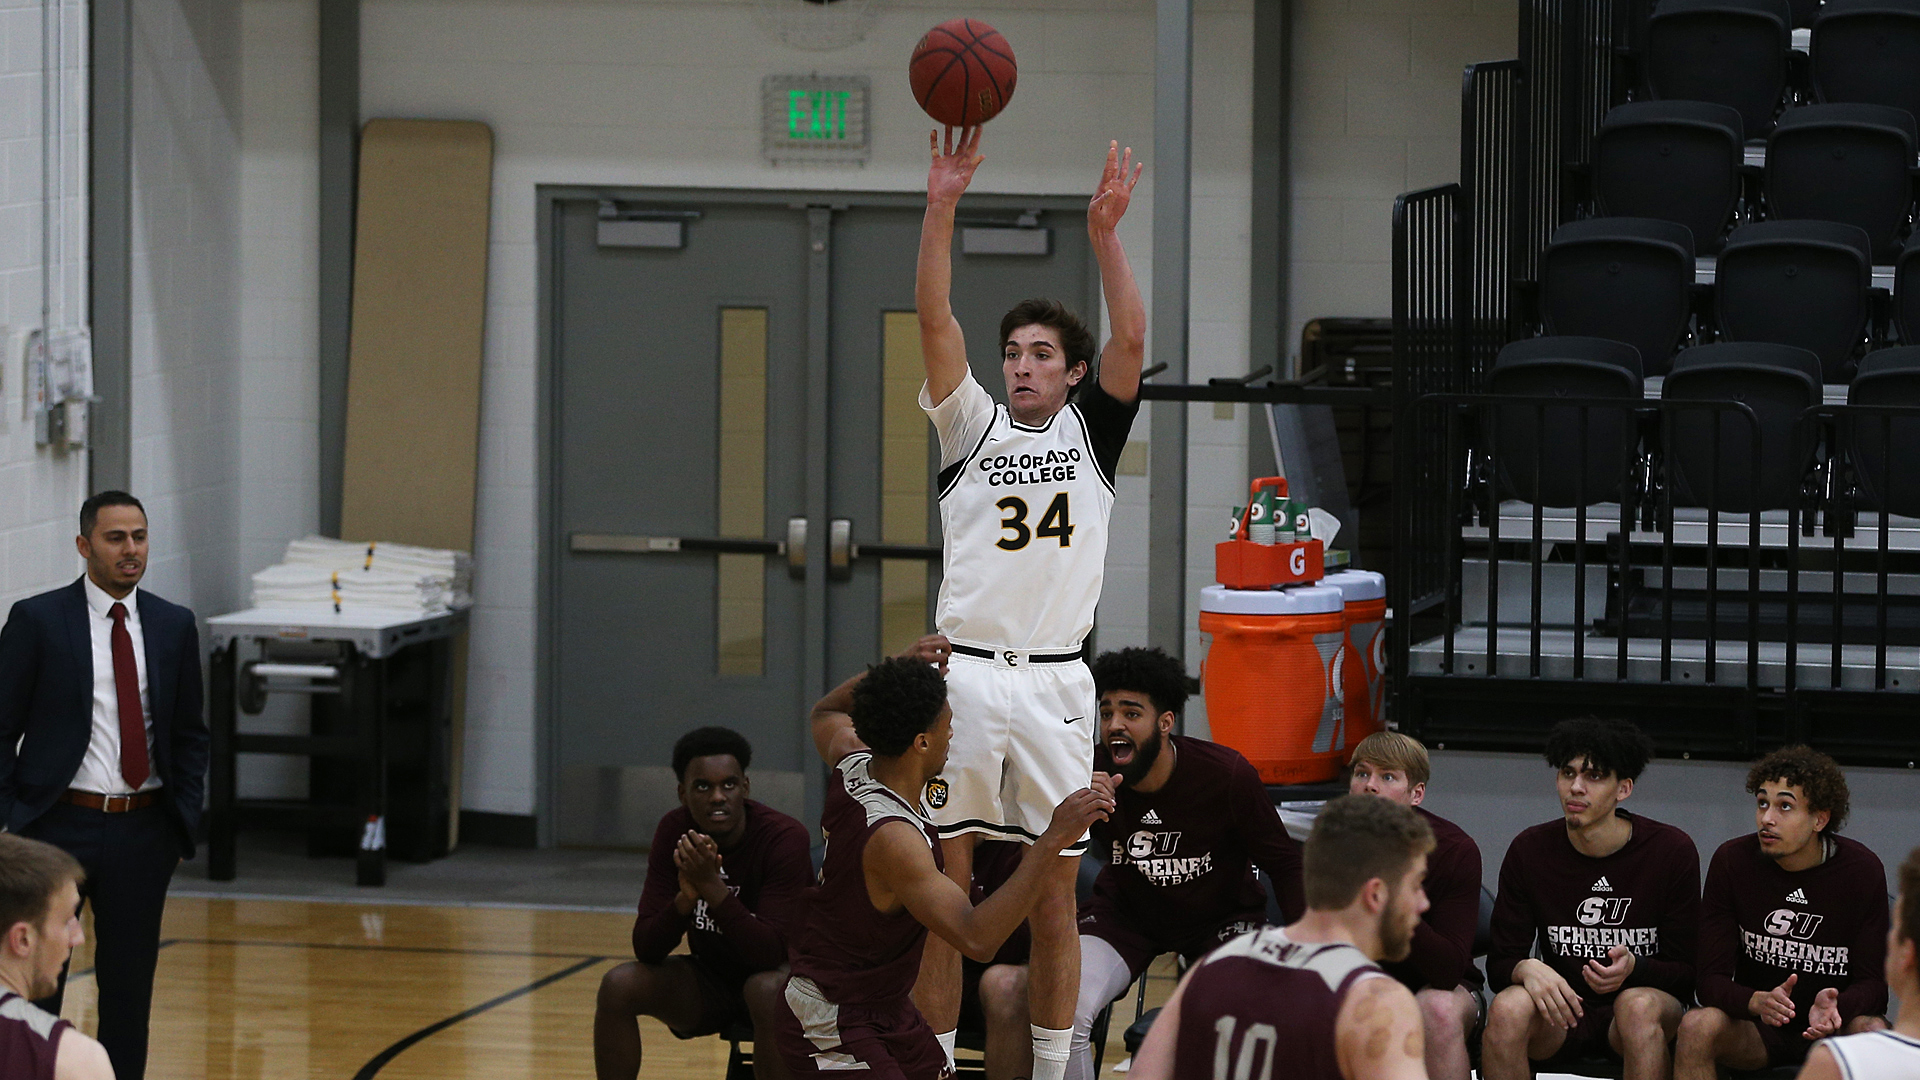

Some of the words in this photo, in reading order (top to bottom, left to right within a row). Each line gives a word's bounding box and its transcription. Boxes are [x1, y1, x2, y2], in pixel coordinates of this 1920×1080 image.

[789, 90, 850, 138] EXIT
[979, 447, 1081, 472] COLORADO
[988, 465, 1076, 487] COLLEGE
[995, 491, 1076, 551] 34
[1290, 547, 1305, 576] G
[1127, 830, 1182, 858] SU
[1576, 896, 1632, 926] SU
[1786, 896, 1808, 905] adidas
[1764, 908, 1824, 940] SU
[1745, 945, 1848, 976] ASKETBALL
[1213, 1014, 1278, 1080] 10
